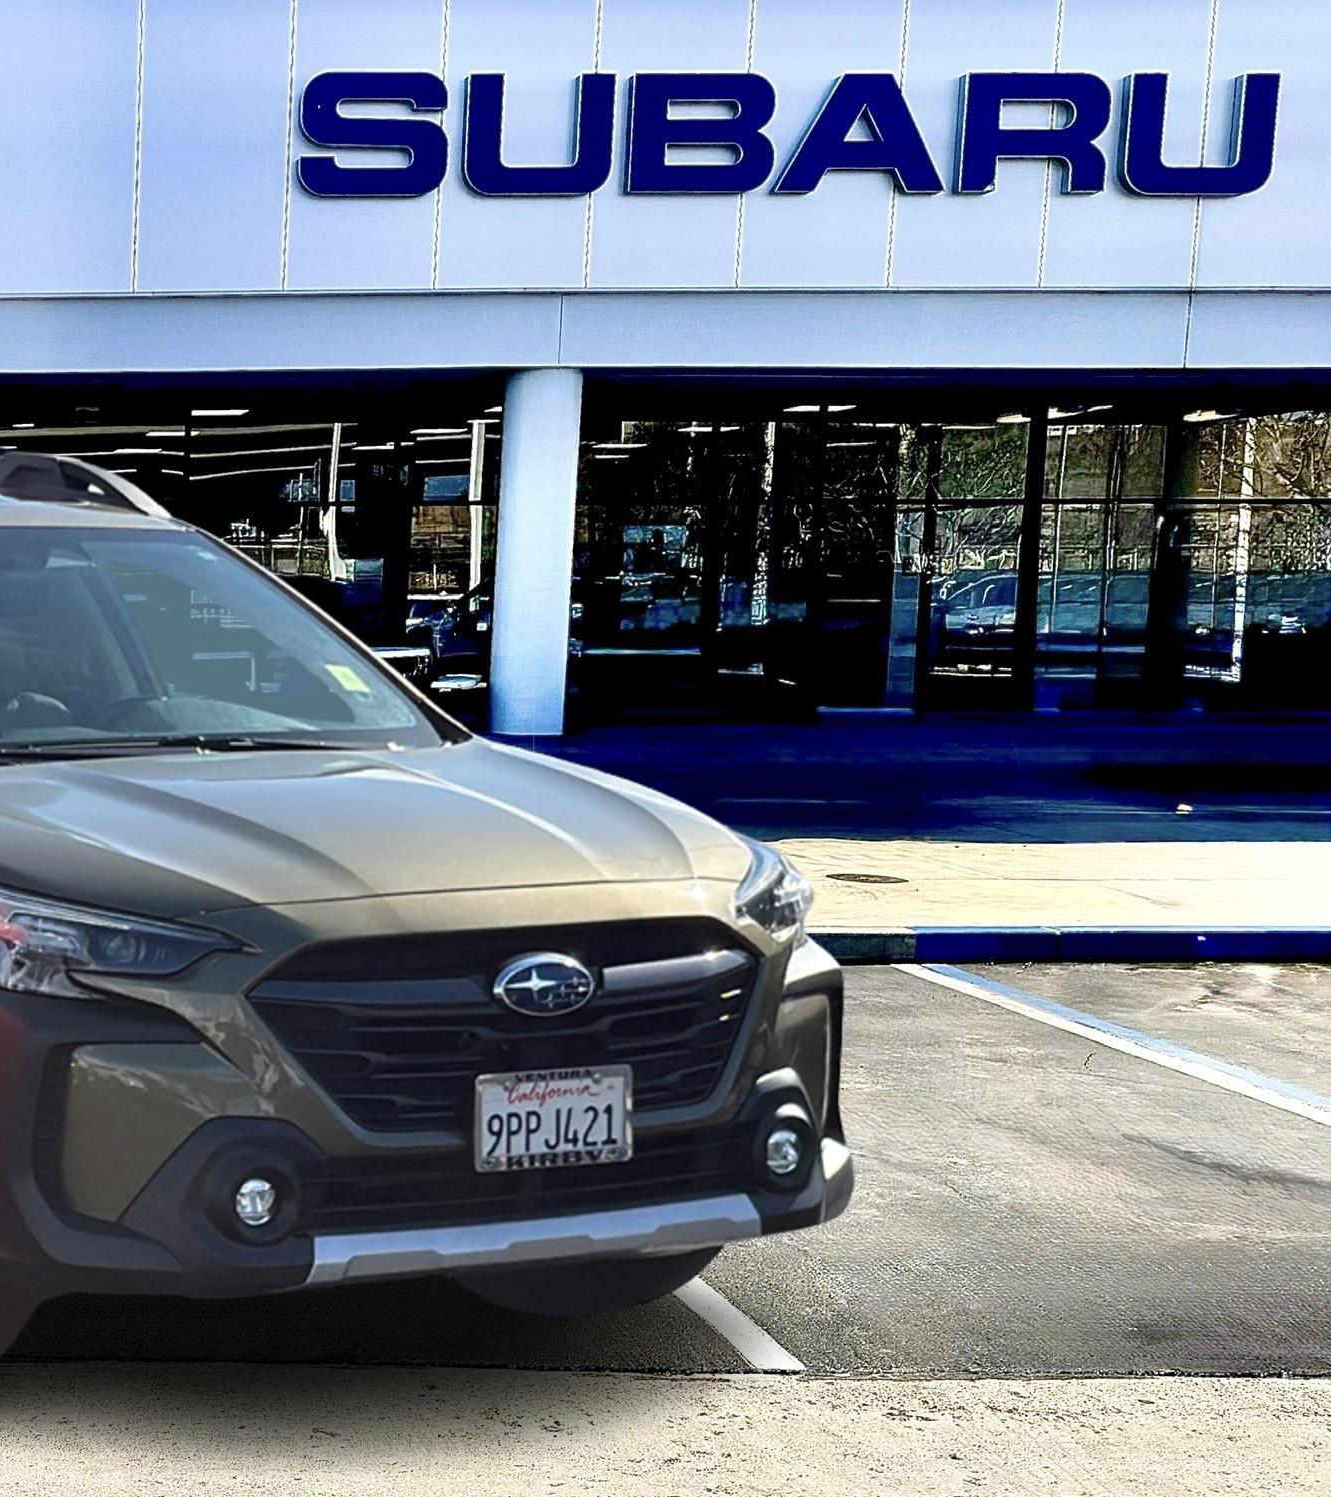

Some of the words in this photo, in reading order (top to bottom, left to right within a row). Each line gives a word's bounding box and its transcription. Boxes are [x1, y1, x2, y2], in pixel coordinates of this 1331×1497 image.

[297, 71, 1279, 197] SUBARU
[514, 1069, 592, 1083] VENTURA
[507, 1080, 600, 1106] California
[486, 1103, 618, 1157] 9PPJ421
[507, 1150, 602, 1169] KIRBY
